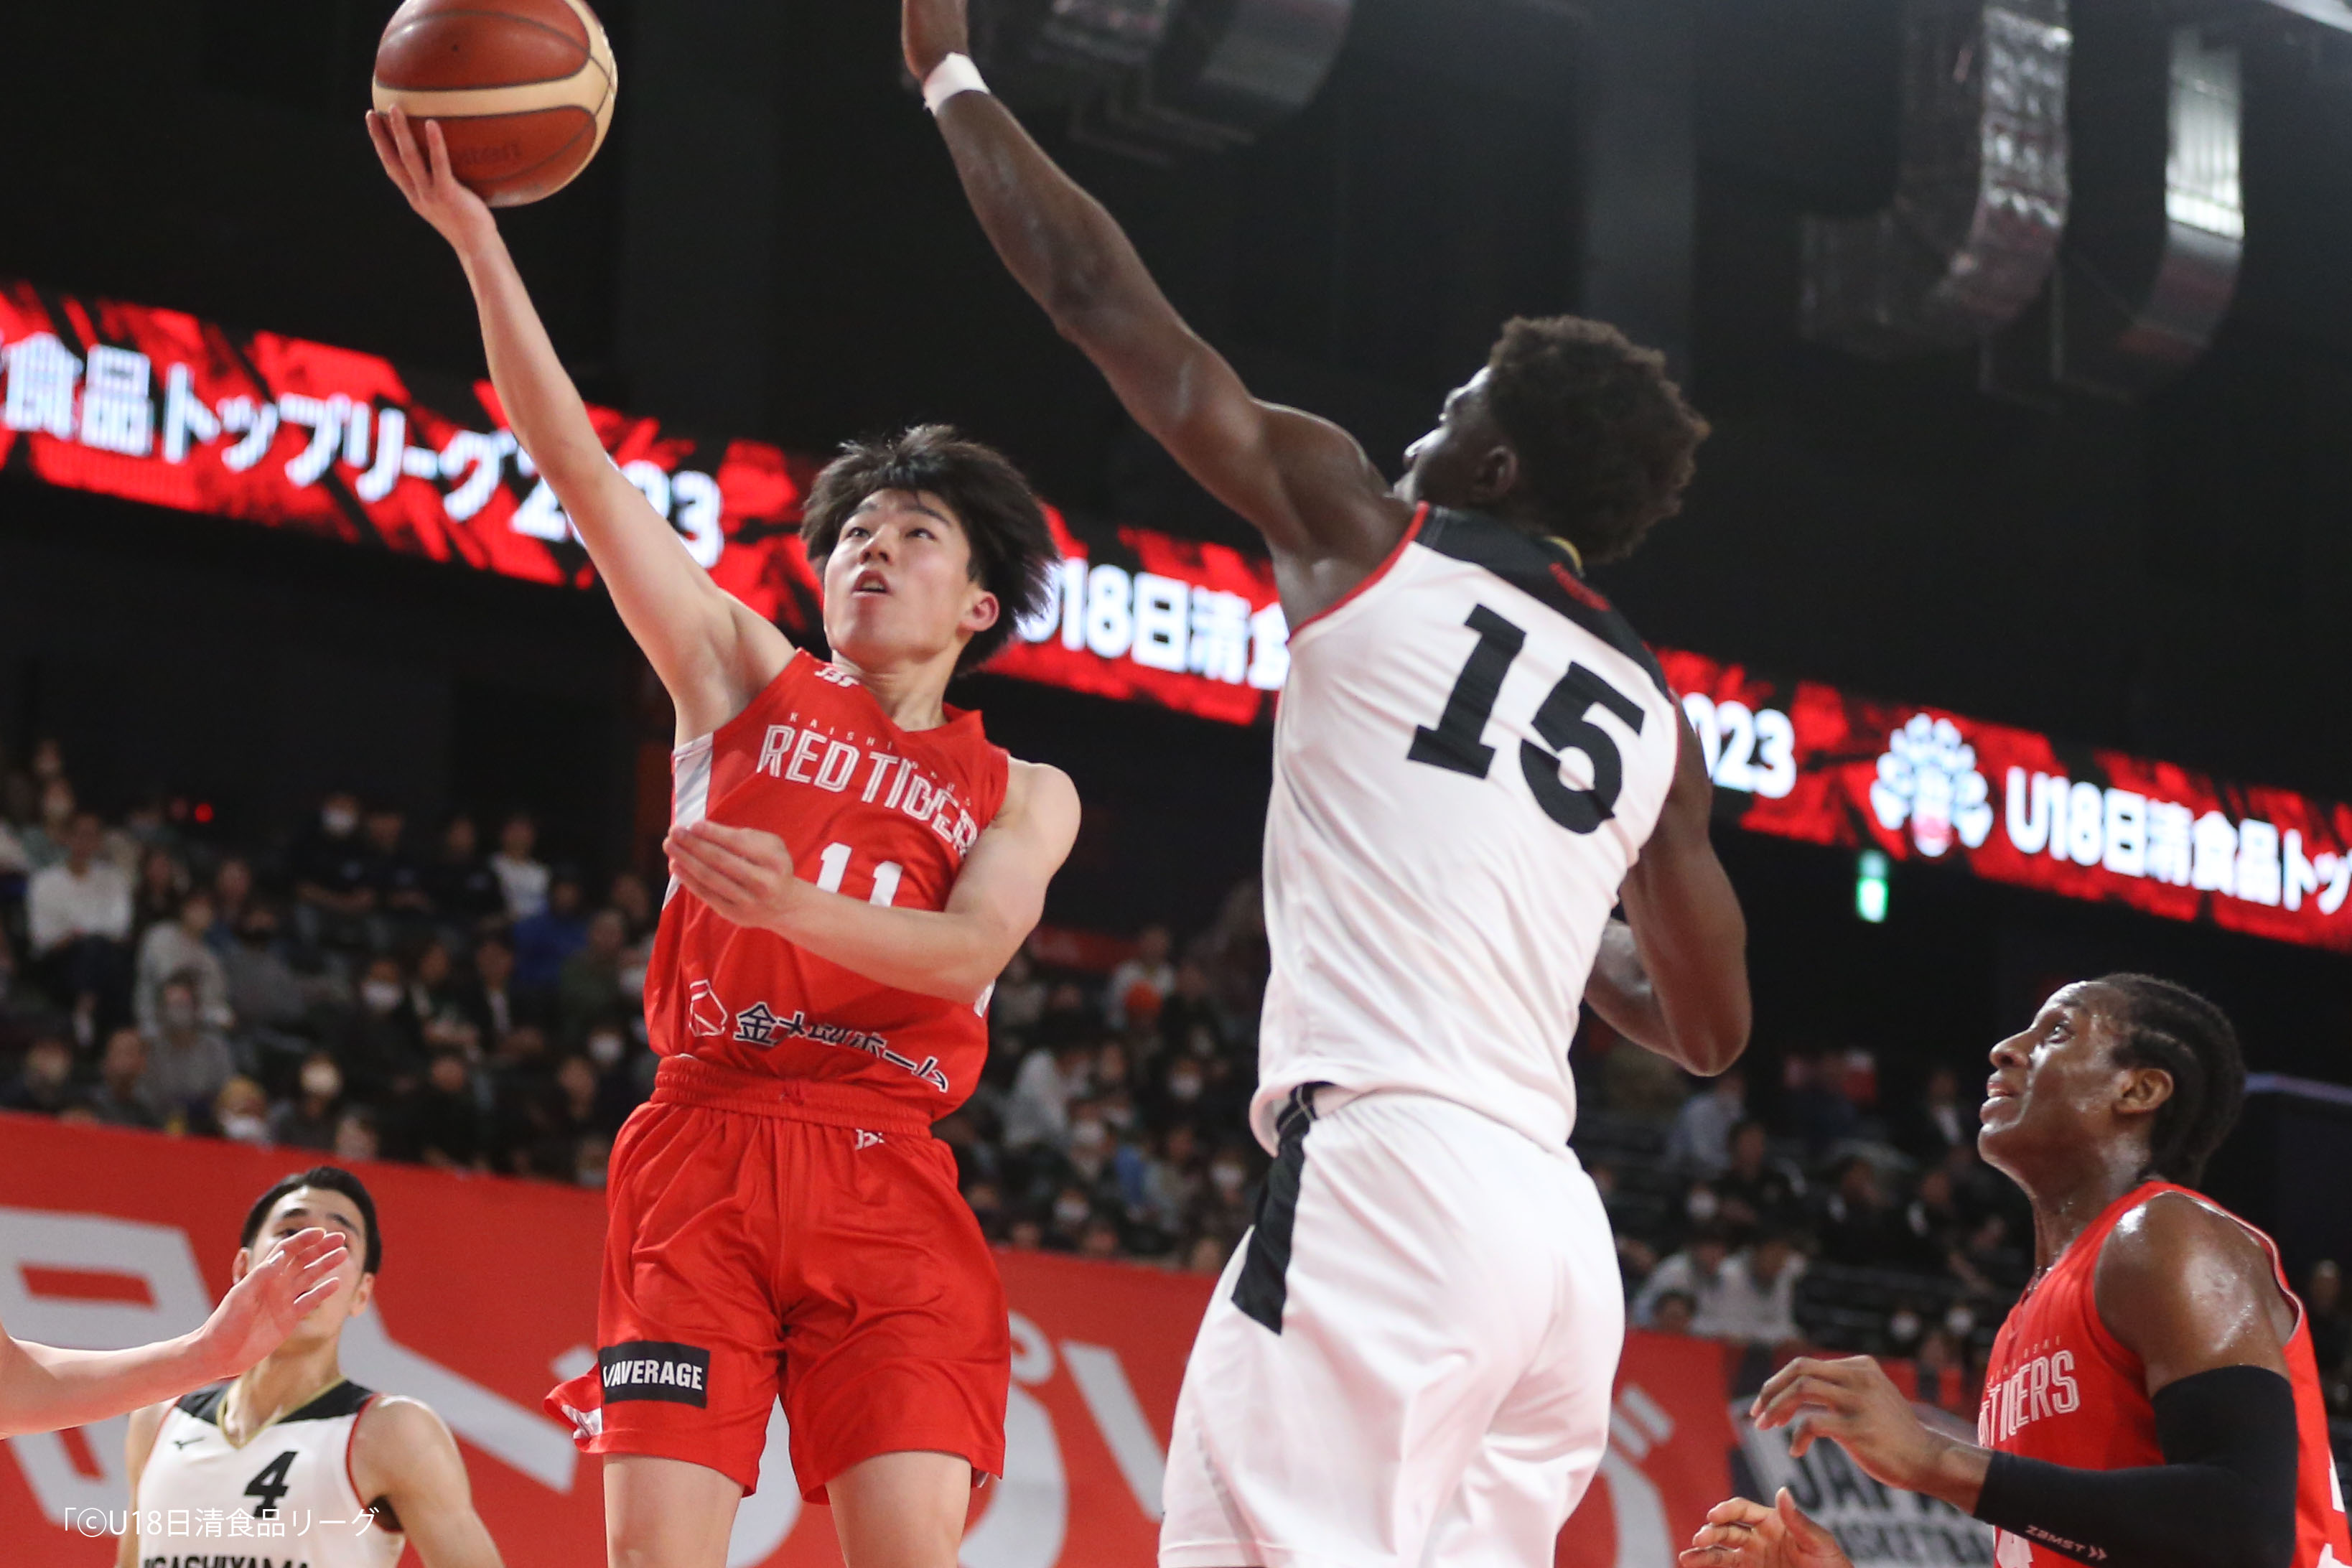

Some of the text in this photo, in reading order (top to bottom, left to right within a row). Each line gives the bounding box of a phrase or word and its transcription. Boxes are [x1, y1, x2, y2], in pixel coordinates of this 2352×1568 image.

[790, 711, 893, 751] KAISHI
[1406, 603, 1645, 836] 15
[756, 724, 860, 793] RED
[244, 1450, 298, 1519] 4
